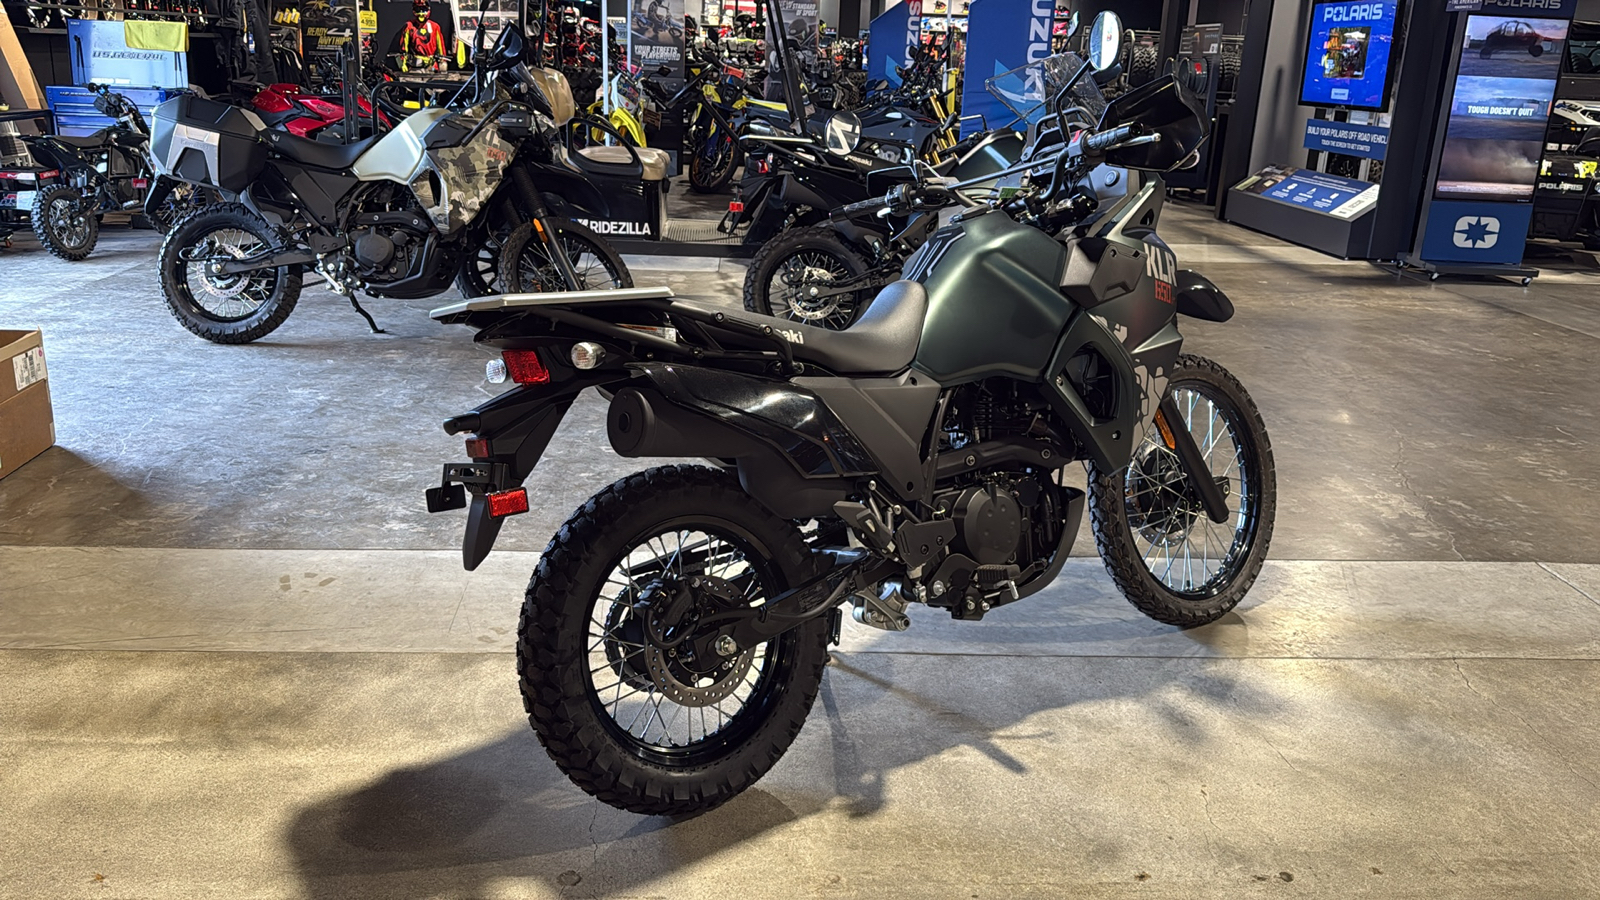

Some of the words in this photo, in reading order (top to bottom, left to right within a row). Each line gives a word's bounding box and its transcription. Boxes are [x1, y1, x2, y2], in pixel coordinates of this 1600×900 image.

[1323, 4, 1383, 22] POLARIS
[634, 45, 651, 54] YOUR
[1468, 105, 1488, 115] TOUGH
[1489, 106, 1518, 116] DOESN'T
[1517, 107, 1534, 117] QUIT
[1307, 126, 1319, 134] BUILD
[1320, 128, 1330, 137] YOUR
[1331, 130, 1348, 138] POLARIS
[1358, 133, 1370, 142] ROAD
[1538, 182, 1584, 191] POLARIS
[590, 220, 652, 236] RIDEZILLA
[1143, 242, 1177, 287] KLR
